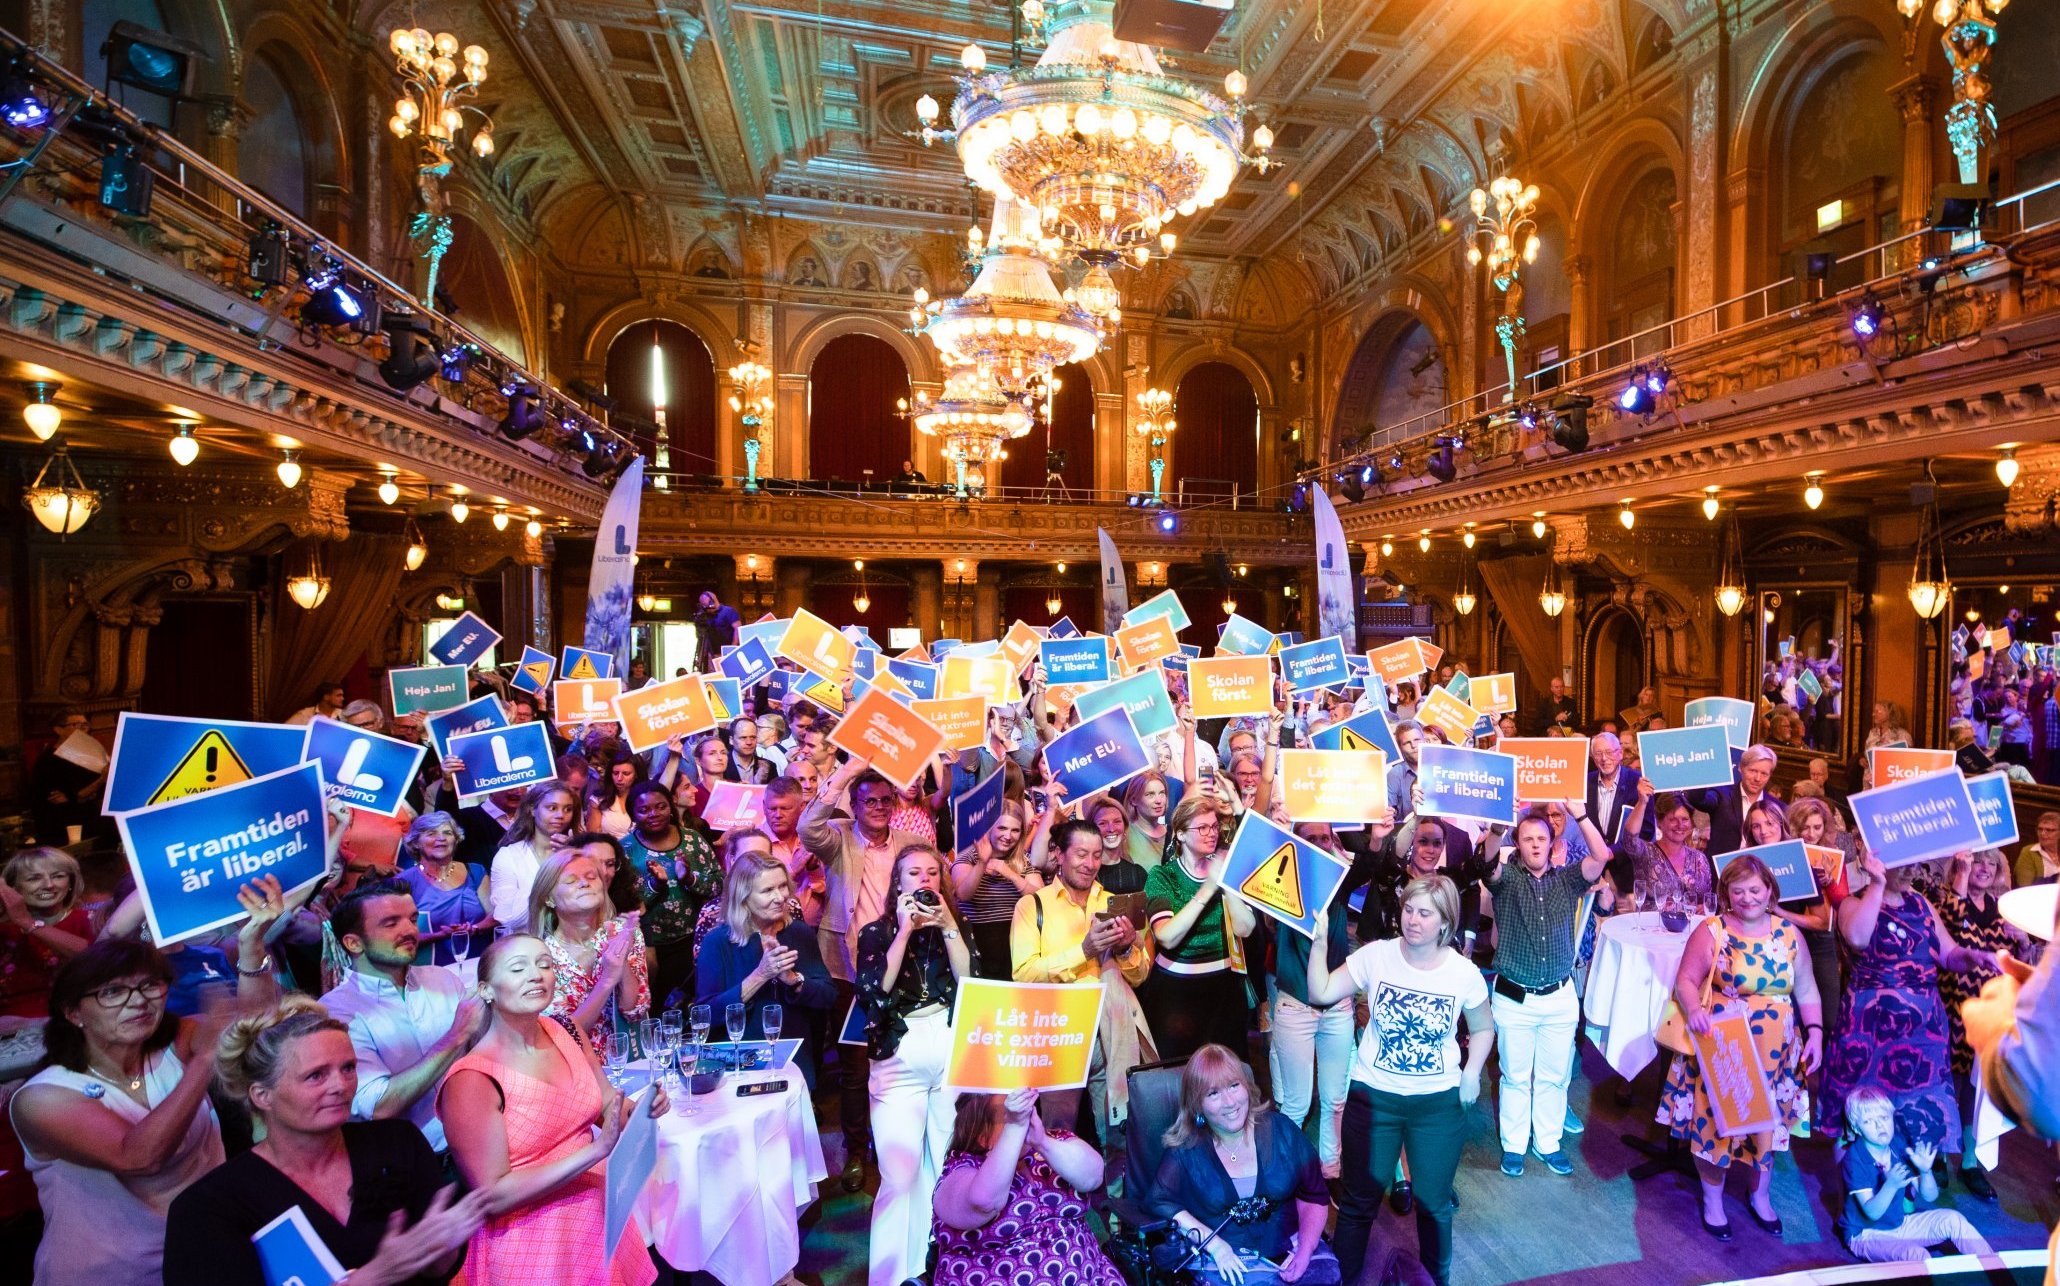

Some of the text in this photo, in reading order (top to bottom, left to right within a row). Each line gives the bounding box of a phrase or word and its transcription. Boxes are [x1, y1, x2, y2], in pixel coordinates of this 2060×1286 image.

[448, 643, 466, 660] Mer
[1049, 651, 1099, 663] Framtiden
[1380, 652, 1410, 665] Skolan
[1052, 661, 1098, 672] är liberal.
[1290, 653, 1337, 669] Framtiden
[1293, 662, 1337, 679] är liberal.
[913, 680, 926, 688] EU.
[1206, 674, 1255, 688] Skolan
[404, 683, 456, 697] Heja Jan!
[1211, 687, 1252, 701] först.
[637, 696, 691, 719] Skolan
[474, 717, 496, 731] EU.
[648, 710, 691, 731] först.
[868, 712, 917, 751] Skolan
[1064, 740, 1121, 773] Mer EU.
[1517, 756, 1567, 769] Skolan
[1655, 748, 1715, 767] Heja Jan!
[475, 769, 536, 789] Liberalerna
[1292, 778, 1316, 790] det
[1432, 766, 1504, 787] Framtiden
[1519, 770, 1562, 785] först.
[1435, 781, 1501, 801] är liberal.
[969, 808, 985, 828] Mer
[1872, 796, 1957, 830] Framtiden
[1883, 811, 1960, 844] är liberal.
[165, 809, 309, 868] Framtiden
[181, 832, 308, 893] är liberal.
[1262, 882, 1290, 899] VARNING
[995, 1008, 1068, 1027] Låt inte
[967, 1026, 1084, 1047] det extrema
[998, 1050, 1053, 1067] vinna.
